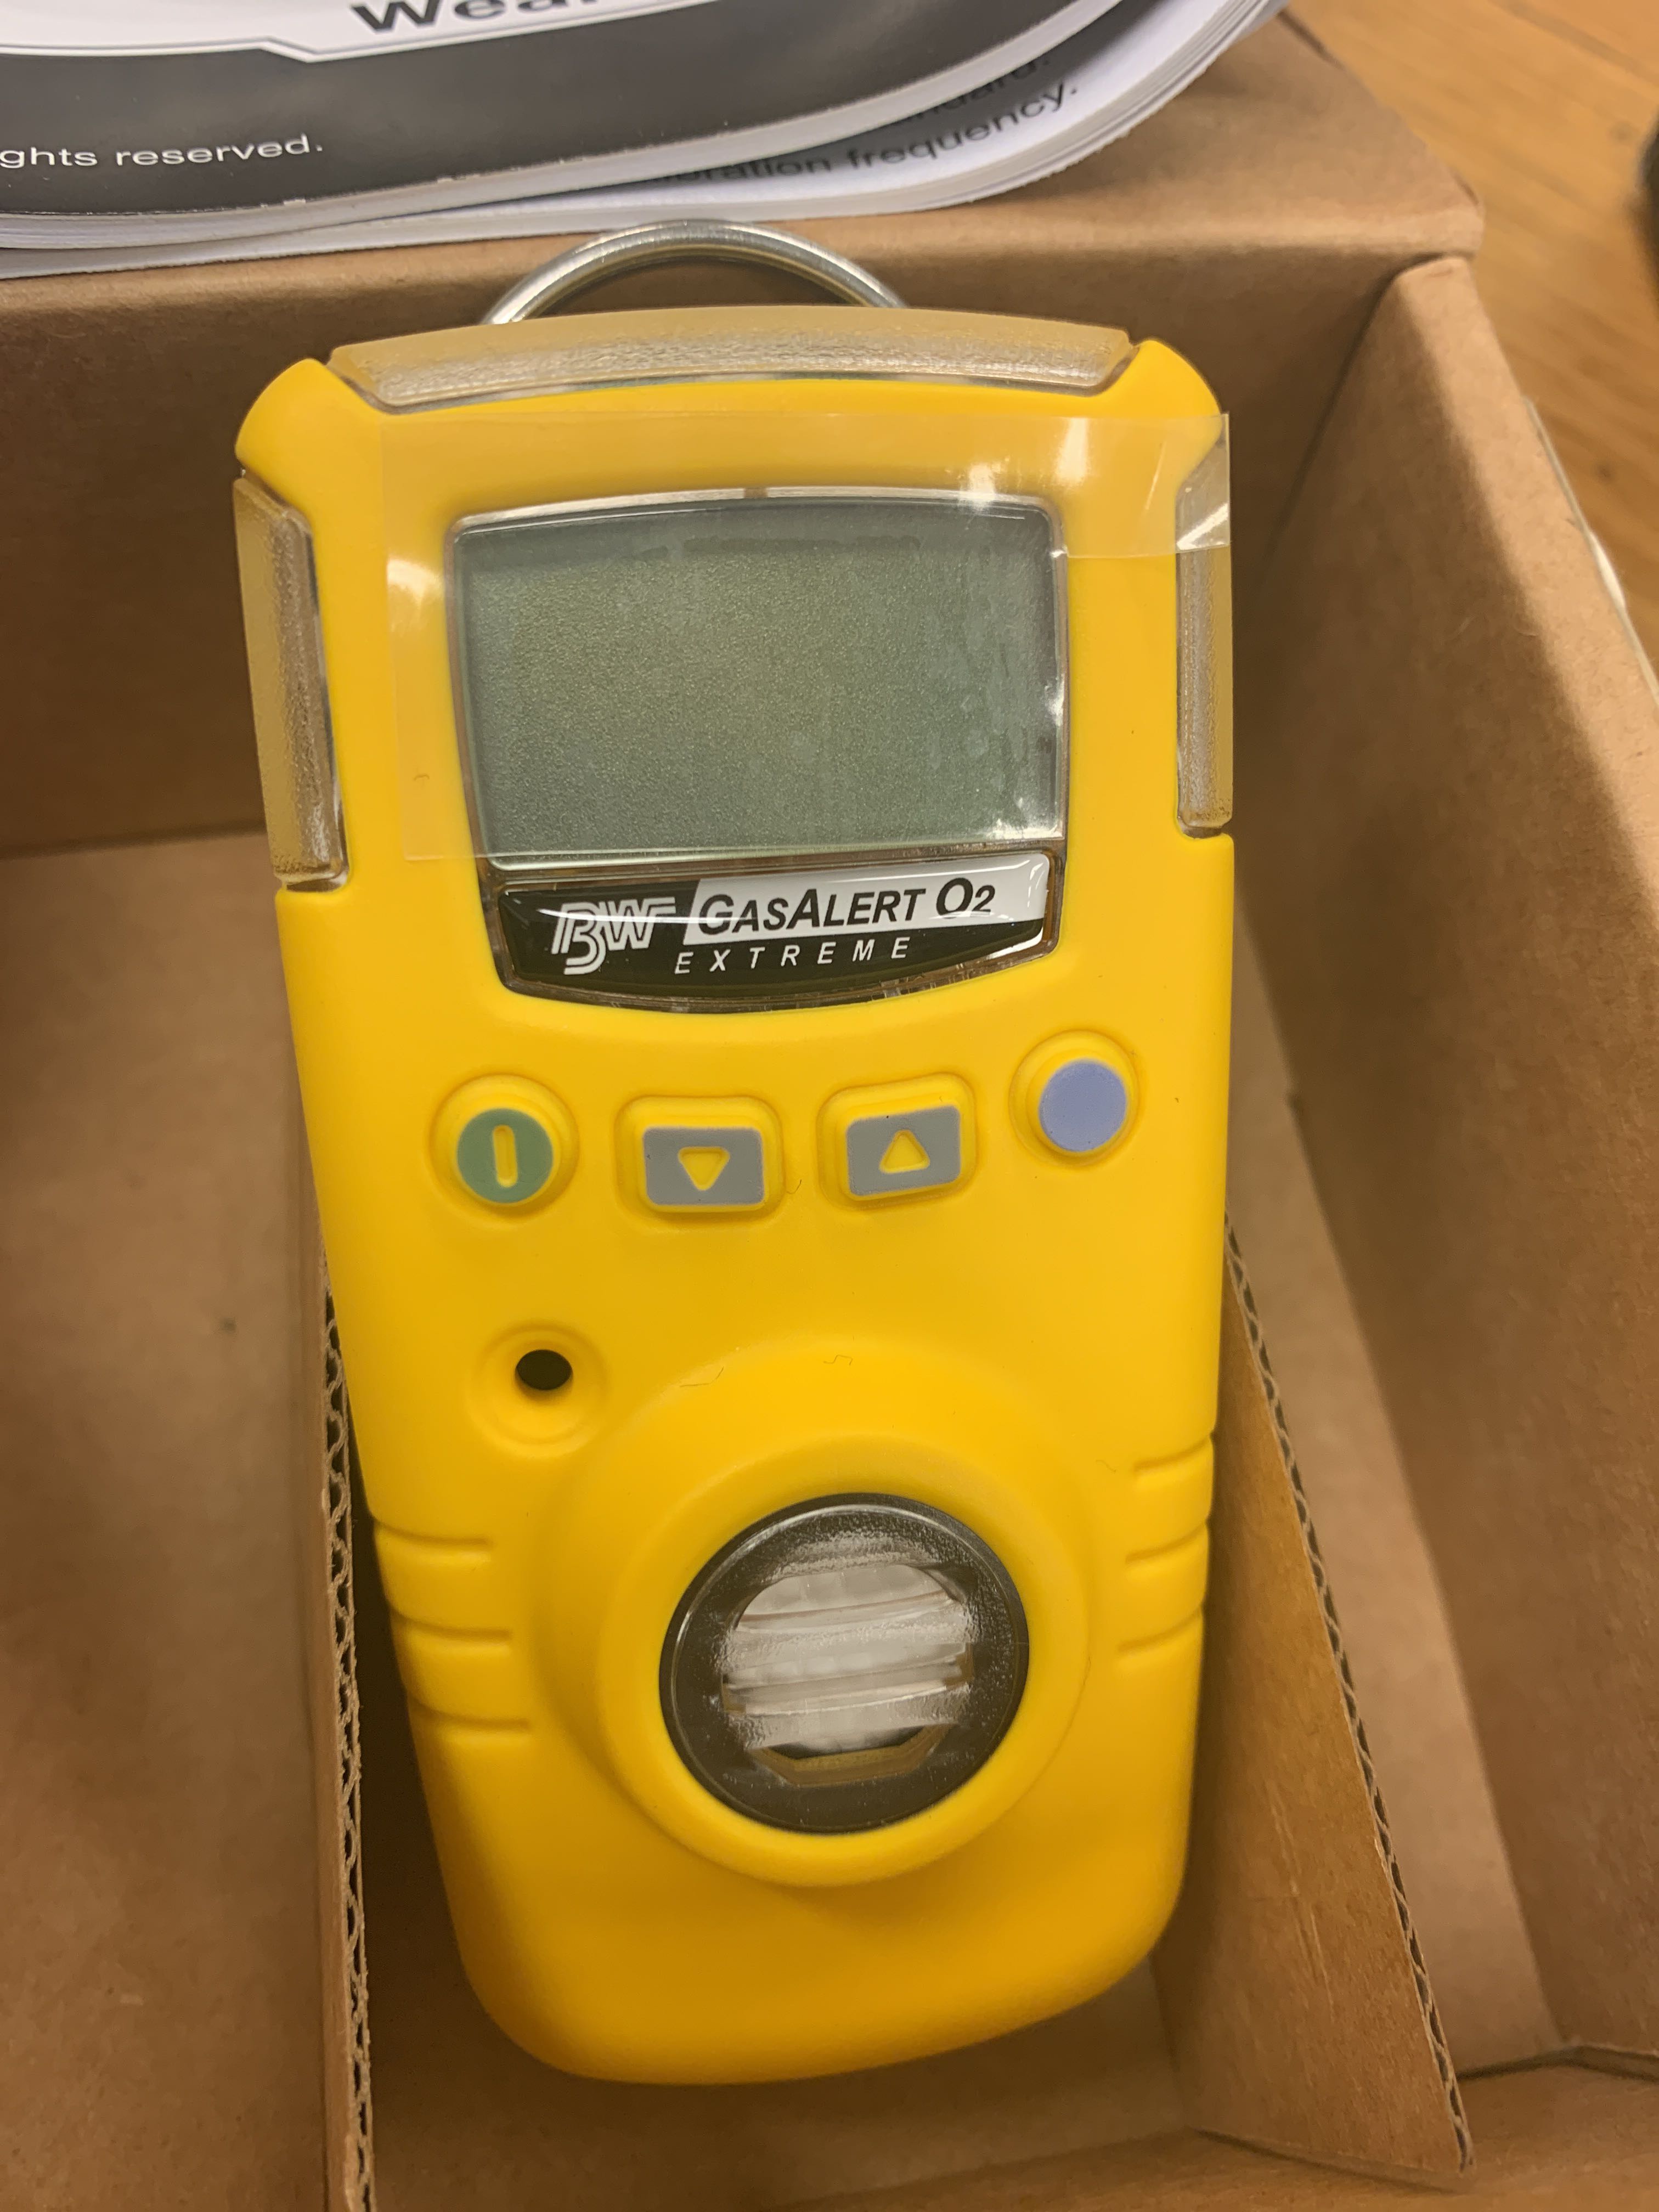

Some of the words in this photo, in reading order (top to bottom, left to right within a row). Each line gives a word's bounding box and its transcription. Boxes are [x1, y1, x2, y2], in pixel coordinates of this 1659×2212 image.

[847, 80, 1077, 168] frequency.
[116, 133, 323, 166] reserved.
[674, 936, 911, 974] EXTREME
